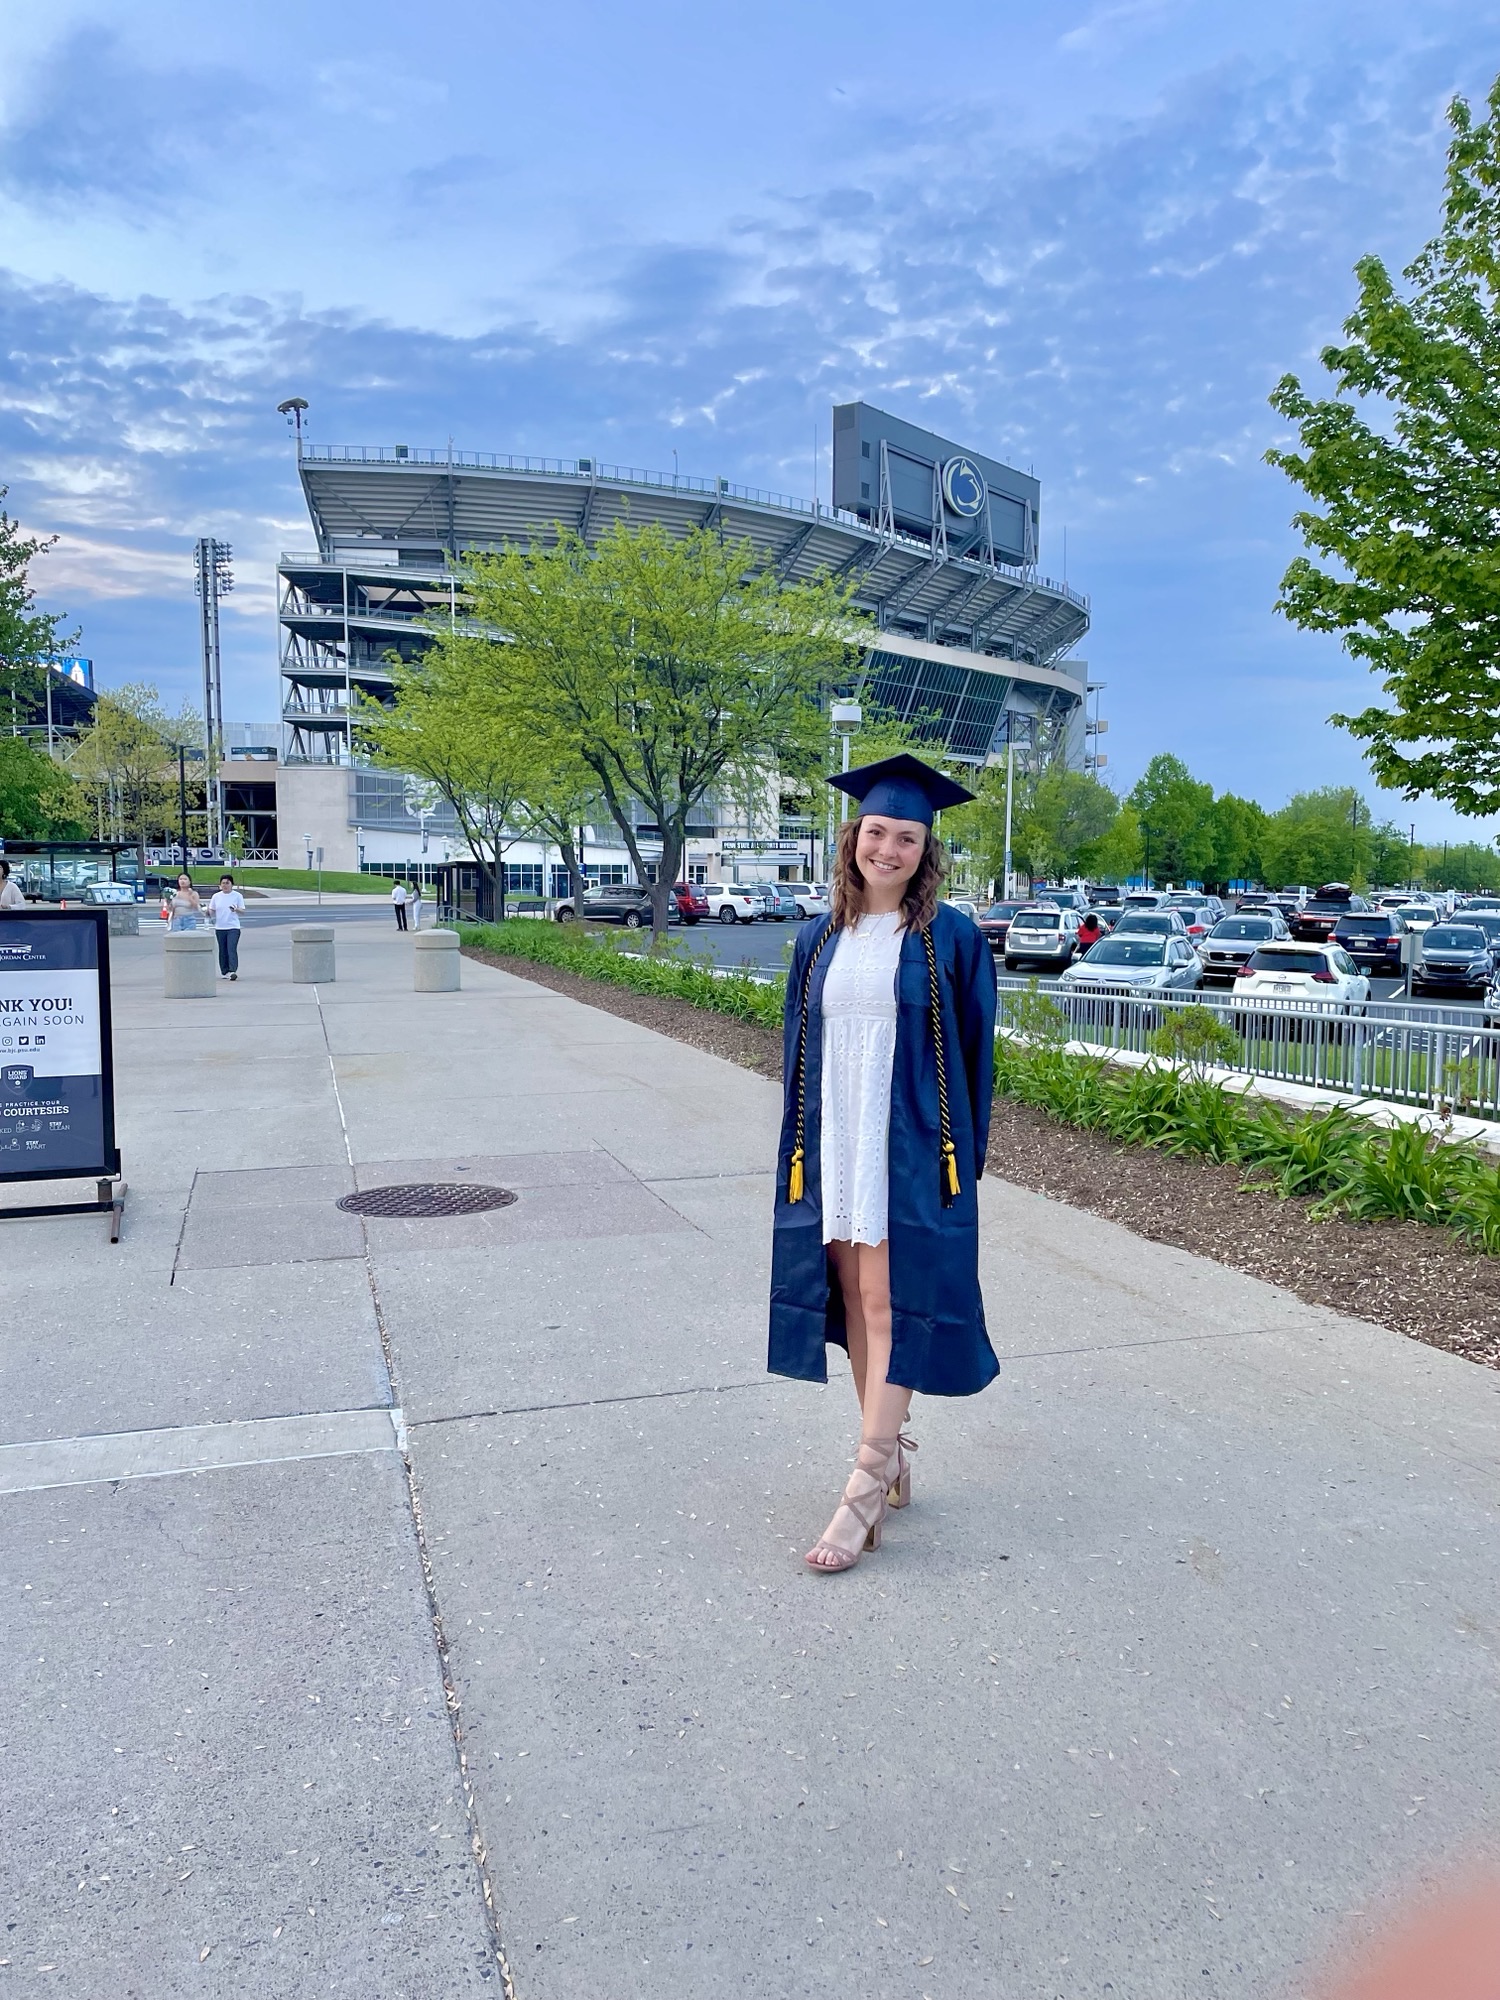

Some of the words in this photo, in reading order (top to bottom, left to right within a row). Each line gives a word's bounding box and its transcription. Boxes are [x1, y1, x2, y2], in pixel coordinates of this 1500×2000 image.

[29, 998, 72, 1011] YOU!
[44, 1015, 84, 1025] SOON
[4, 1106, 69, 1116] COURTESIES
